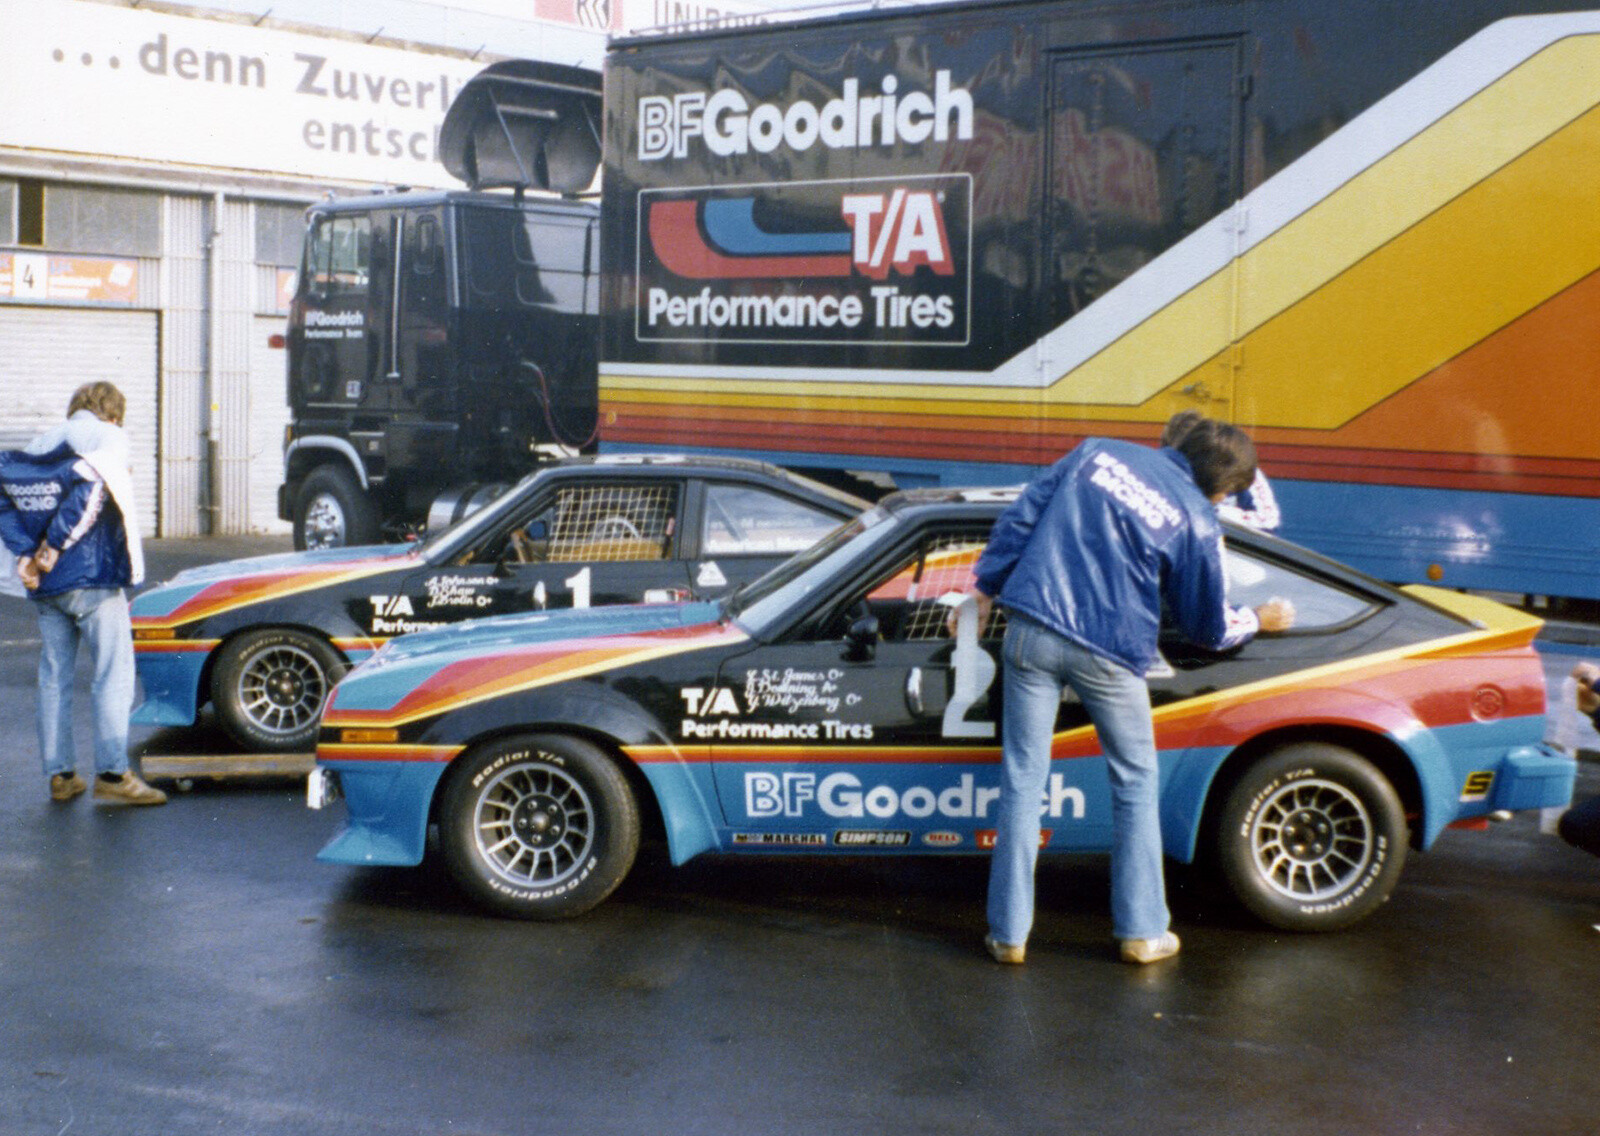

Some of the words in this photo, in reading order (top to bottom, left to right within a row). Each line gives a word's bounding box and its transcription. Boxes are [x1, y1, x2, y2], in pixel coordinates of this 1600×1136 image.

[140, 34, 267, 89] denn
[294, 53, 459, 112] Zuverl
[638, 69, 974, 161] BFGoodrich
[843, 189, 945, 267] T/A
[23, 264, 34, 289] 4
[648, 287, 863, 327] Performance
[871, 286, 955, 328] Tires
[369, 595, 415, 617] T/A
[565, 566, 591, 608] 1
[681, 688, 740, 716] T/A
[682, 720, 819, 740] Performance
[822, 720, 874, 740] Tires
[472, 751, 530, 788] Radial
[537, 751, 566, 766] T/A
[745, 772, 1086, 818] BFGoodrh
[763, 833, 825, 845] MARCHAL
[839, 831, 907, 845] SIMPSON
[489, 856, 599, 900] BFGoodrich
